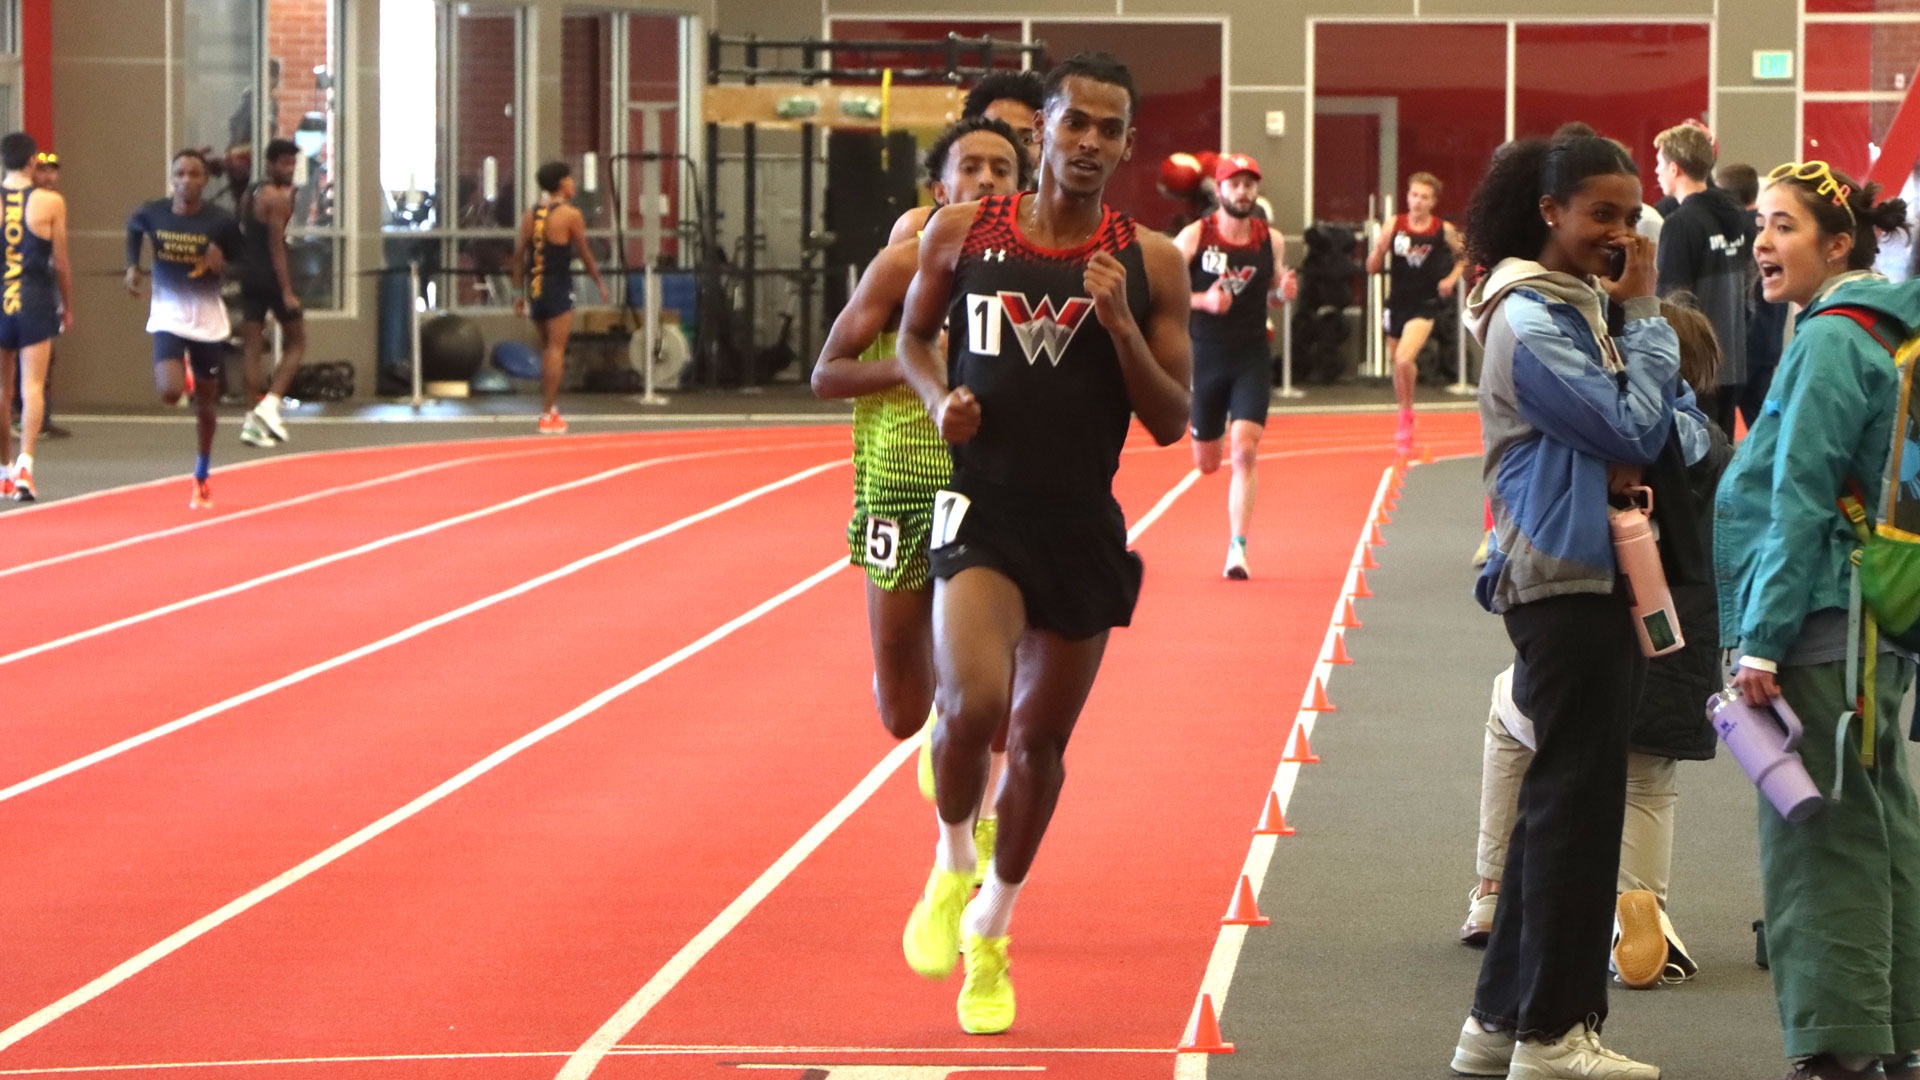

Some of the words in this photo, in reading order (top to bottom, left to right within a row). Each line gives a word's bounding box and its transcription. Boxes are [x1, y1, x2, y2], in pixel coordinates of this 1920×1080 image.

[3, 192, 24, 315] TROJANS
[156, 229, 207, 244] TRINIDAD
[163, 242, 197, 254] STATE
[1205, 254, 1221, 272] 12
[974, 299, 989, 350] 1
[871, 518, 892, 560] 5
[941, 496, 957, 545] 1
